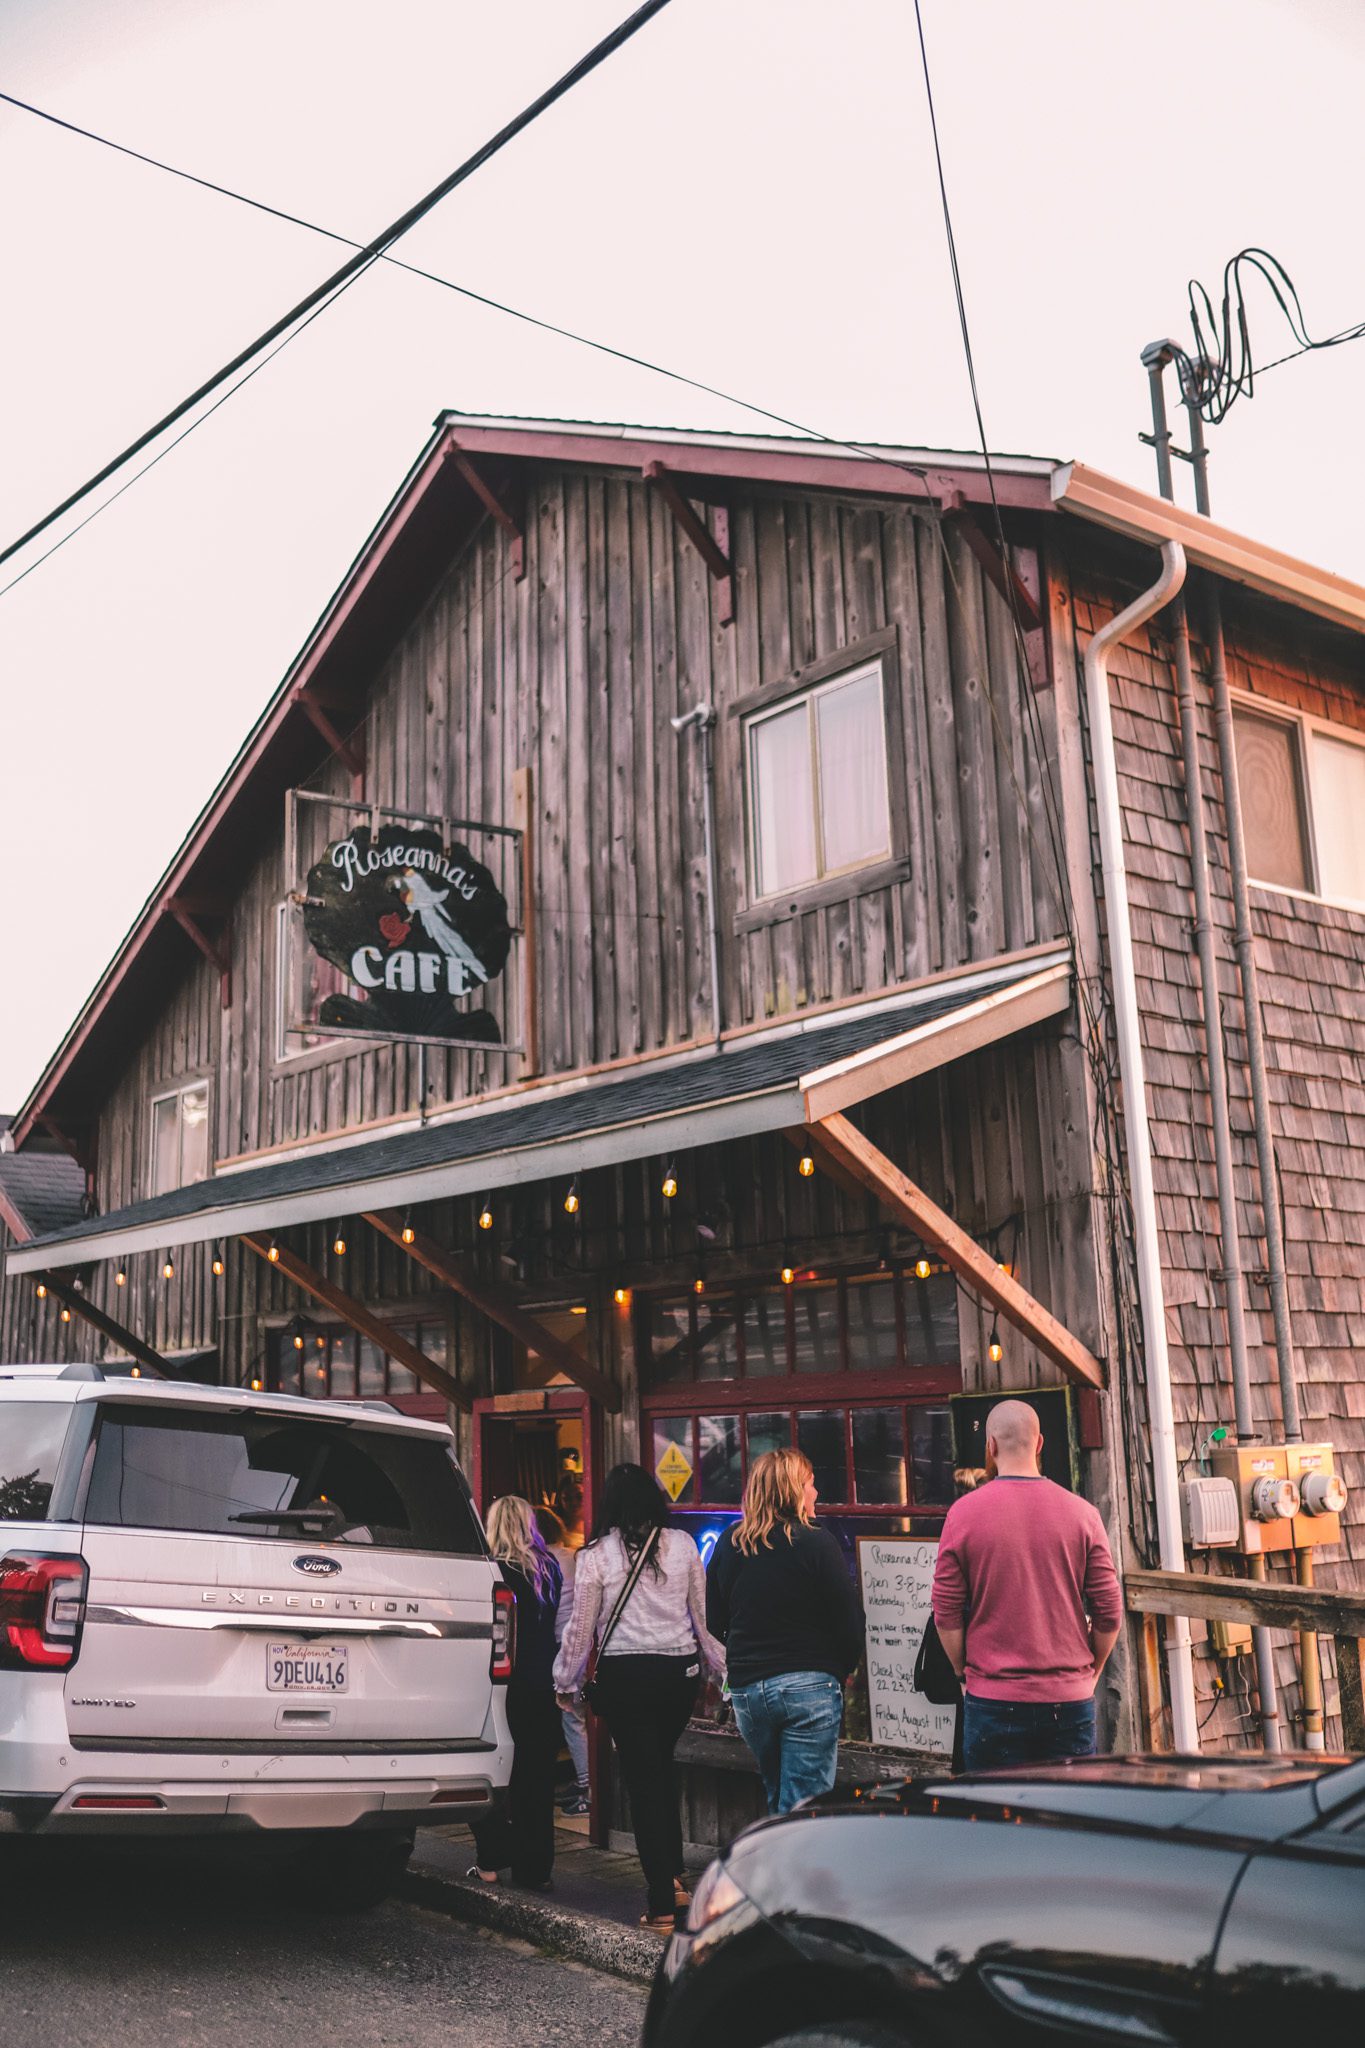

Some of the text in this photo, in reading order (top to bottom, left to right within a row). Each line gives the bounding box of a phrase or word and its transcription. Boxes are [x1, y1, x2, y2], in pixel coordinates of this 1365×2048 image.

[332, 838, 478, 900] Roseanna's
[351, 946, 473, 996] CAFE
[303, 1559, 332, 1573] Ford
[864, 1570, 889, 1592] Open
[201, 1592, 419, 1614] EXPEDITION
[868, 1594, 905, 1616] Wednesday
[285, 1646, 335, 1661] California
[273, 1660, 346, 1686] 9DEU416
[71, 1697, 137, 1709] LIMITED
[875, 1703, 900, 1732] Friday
[901, 1707, 929, 1734] August
